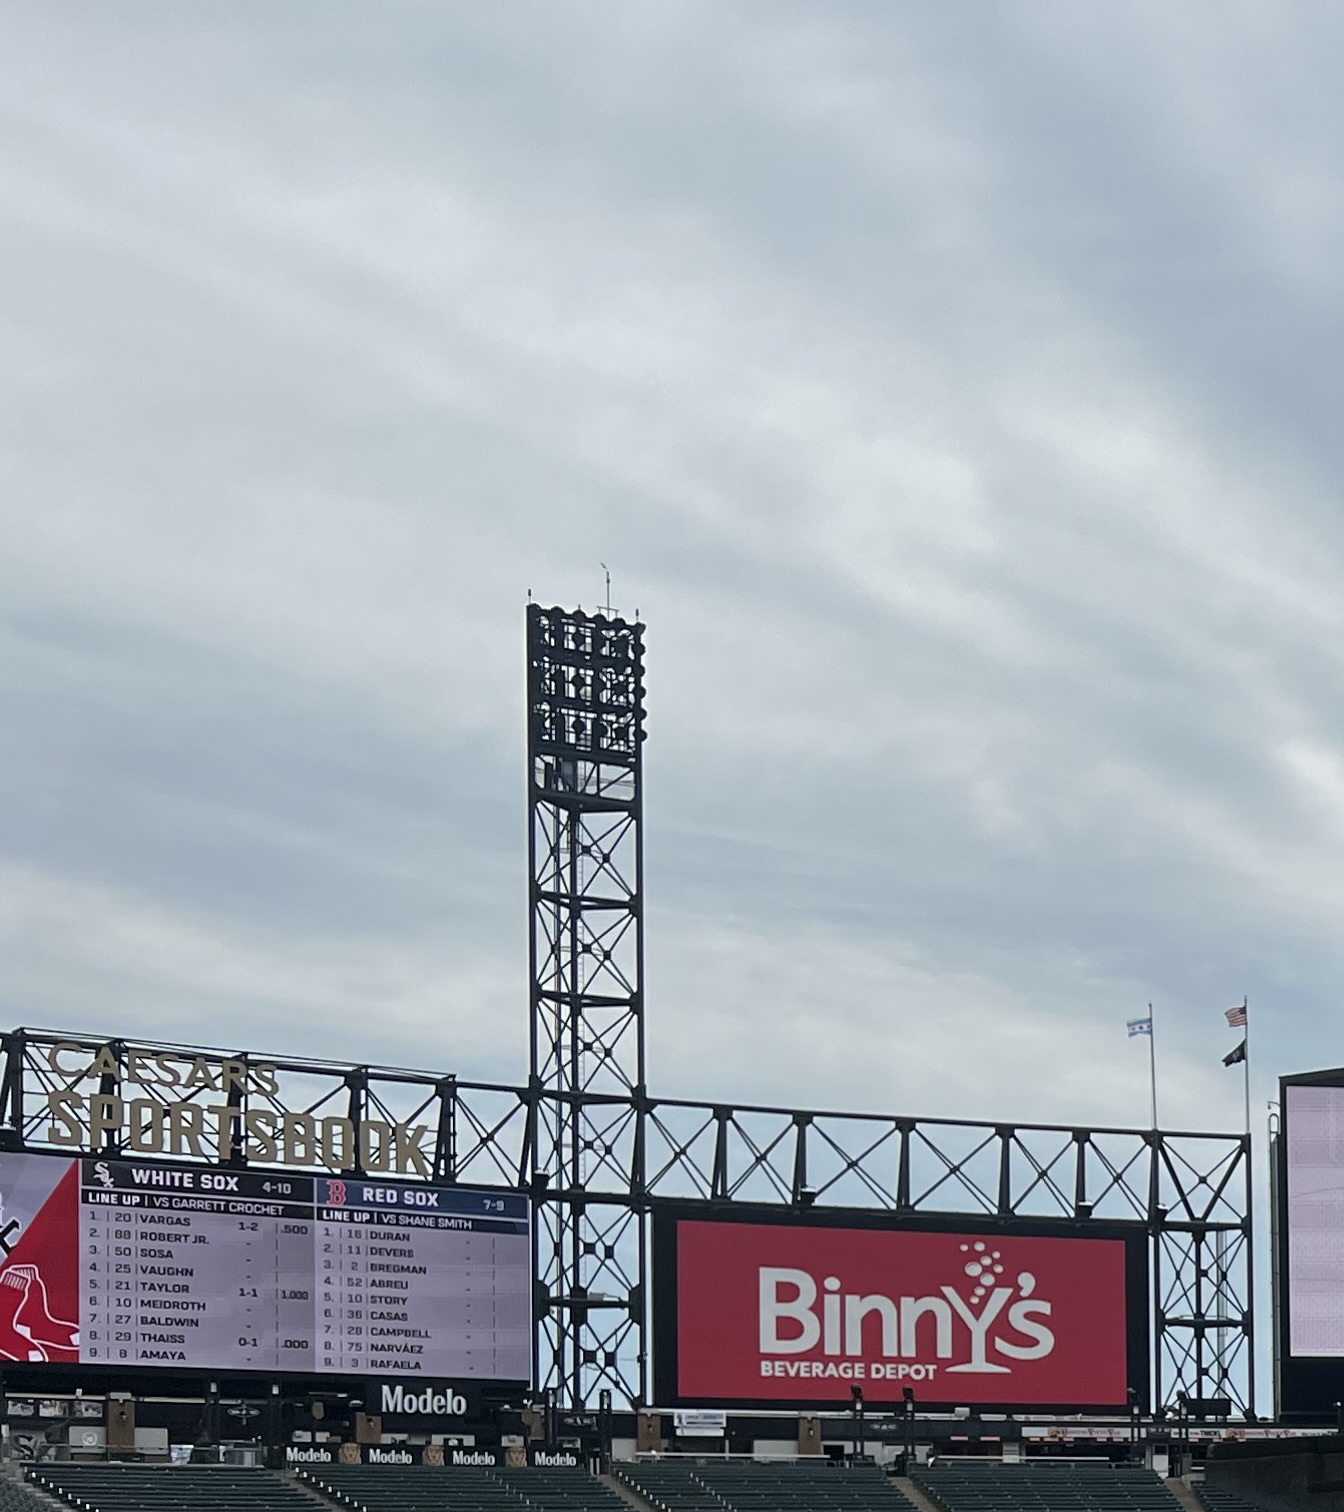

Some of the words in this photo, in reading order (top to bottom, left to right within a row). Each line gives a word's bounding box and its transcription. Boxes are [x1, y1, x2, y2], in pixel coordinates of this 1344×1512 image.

[48, 1042, 279, 1097] CAESARS
[48, 1090, 430, 1177] SPORTSBOOK
[132, 1169, 194, 1187] WHITE
[200, 1176, 239, 1191] SOX
[262, 1183, 291, 1194] 4-10
[88, 1192, 118, 1204] LINE
[122, 1194, 140, 1206] UP
[153, 1197, 169, 1207] VS
[172, 1199, 226, 1212] GARRETT
[229, 1202, 284, 1215] CROCHET
[362, 1187, 398, 1203] RED
[404, 1191, 439, 1207] SOX
[140, 1214, 191, 1226] VARGAS
[323, 1209, 350, 1221] LINE
[354, 1212, 370, 1223] UP
[381, 1214, 396, 1223] VS
[398, 1215, 435, 1227] SHANE
[438, 1218, 472, 1230] SMITH
[140, 1231, 189, 1243] ROBERT
[192, 1234, 209, 1244] JR.
[370, 1231, 410, 1242] DURAN
[140, 1248, 174, 1259] SOSA
[140, 1265, 194, 1277] VAUGHN
[140, 1282, 189, 1293] TAYLOR
[140, 1299, 206, 1311] MEIDROTH
[140, 1316, 199, 1327] BALDWIN
[140, 1333, 185, 1344] THAISS
[140, 1350, 186, 1361] AMAYA
[761, 1361, 865, 1379] BEVERAGE
[871, 1364, 937, 1381] DEPOT
[382, 1384, 466, 1416] Modelo
[286, 1447, 332, 1464] Modelo
[369, 1448, 412, 1465] Modelo
[453, 1450, 495, 1466] Modelo
[535, 1451, 577, 1467] Modelo
